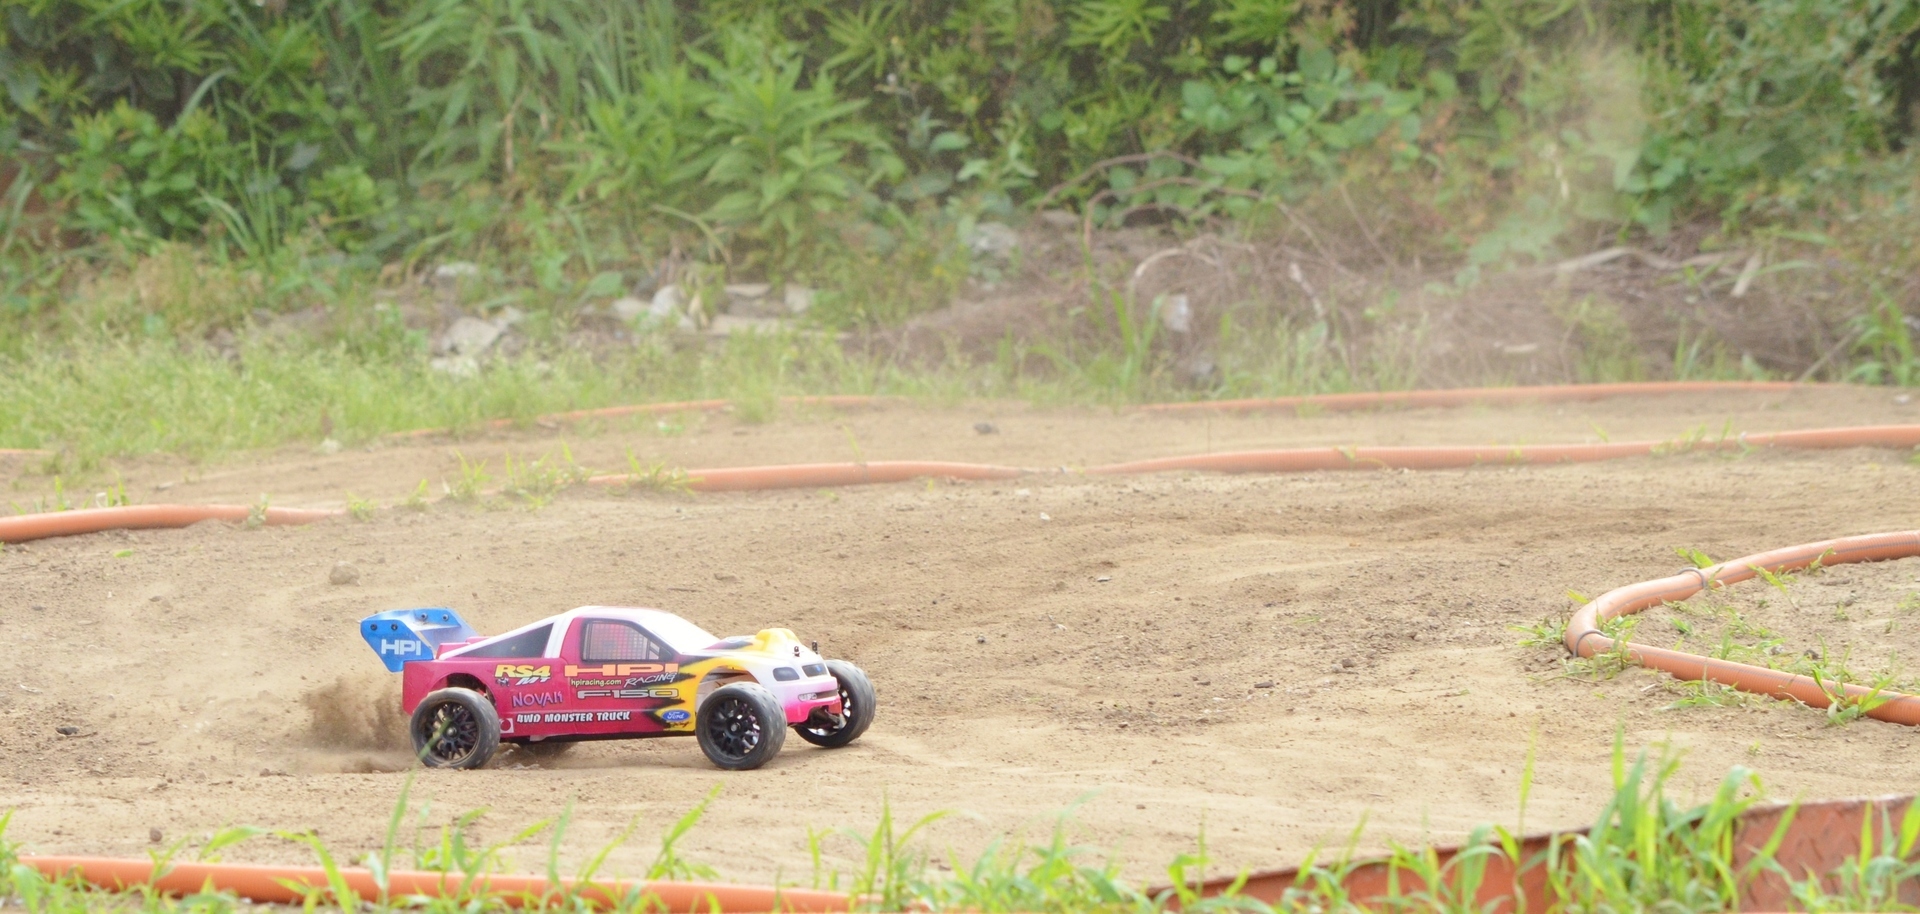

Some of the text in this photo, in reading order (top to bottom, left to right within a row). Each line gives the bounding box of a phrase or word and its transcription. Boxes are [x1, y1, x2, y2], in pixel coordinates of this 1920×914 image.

[381, 639, 421, 656] HPI
[494, 664, 551, 678] RS4
[564, 663, 679, 677] HPI
[570, 679, 622, 688] hpiracing.com
[623, 672, 677, 688] RACING
[577, 688, 679, 699] F-150
[516, 711, 631, 724] 4WD MONSTER TRUCK
